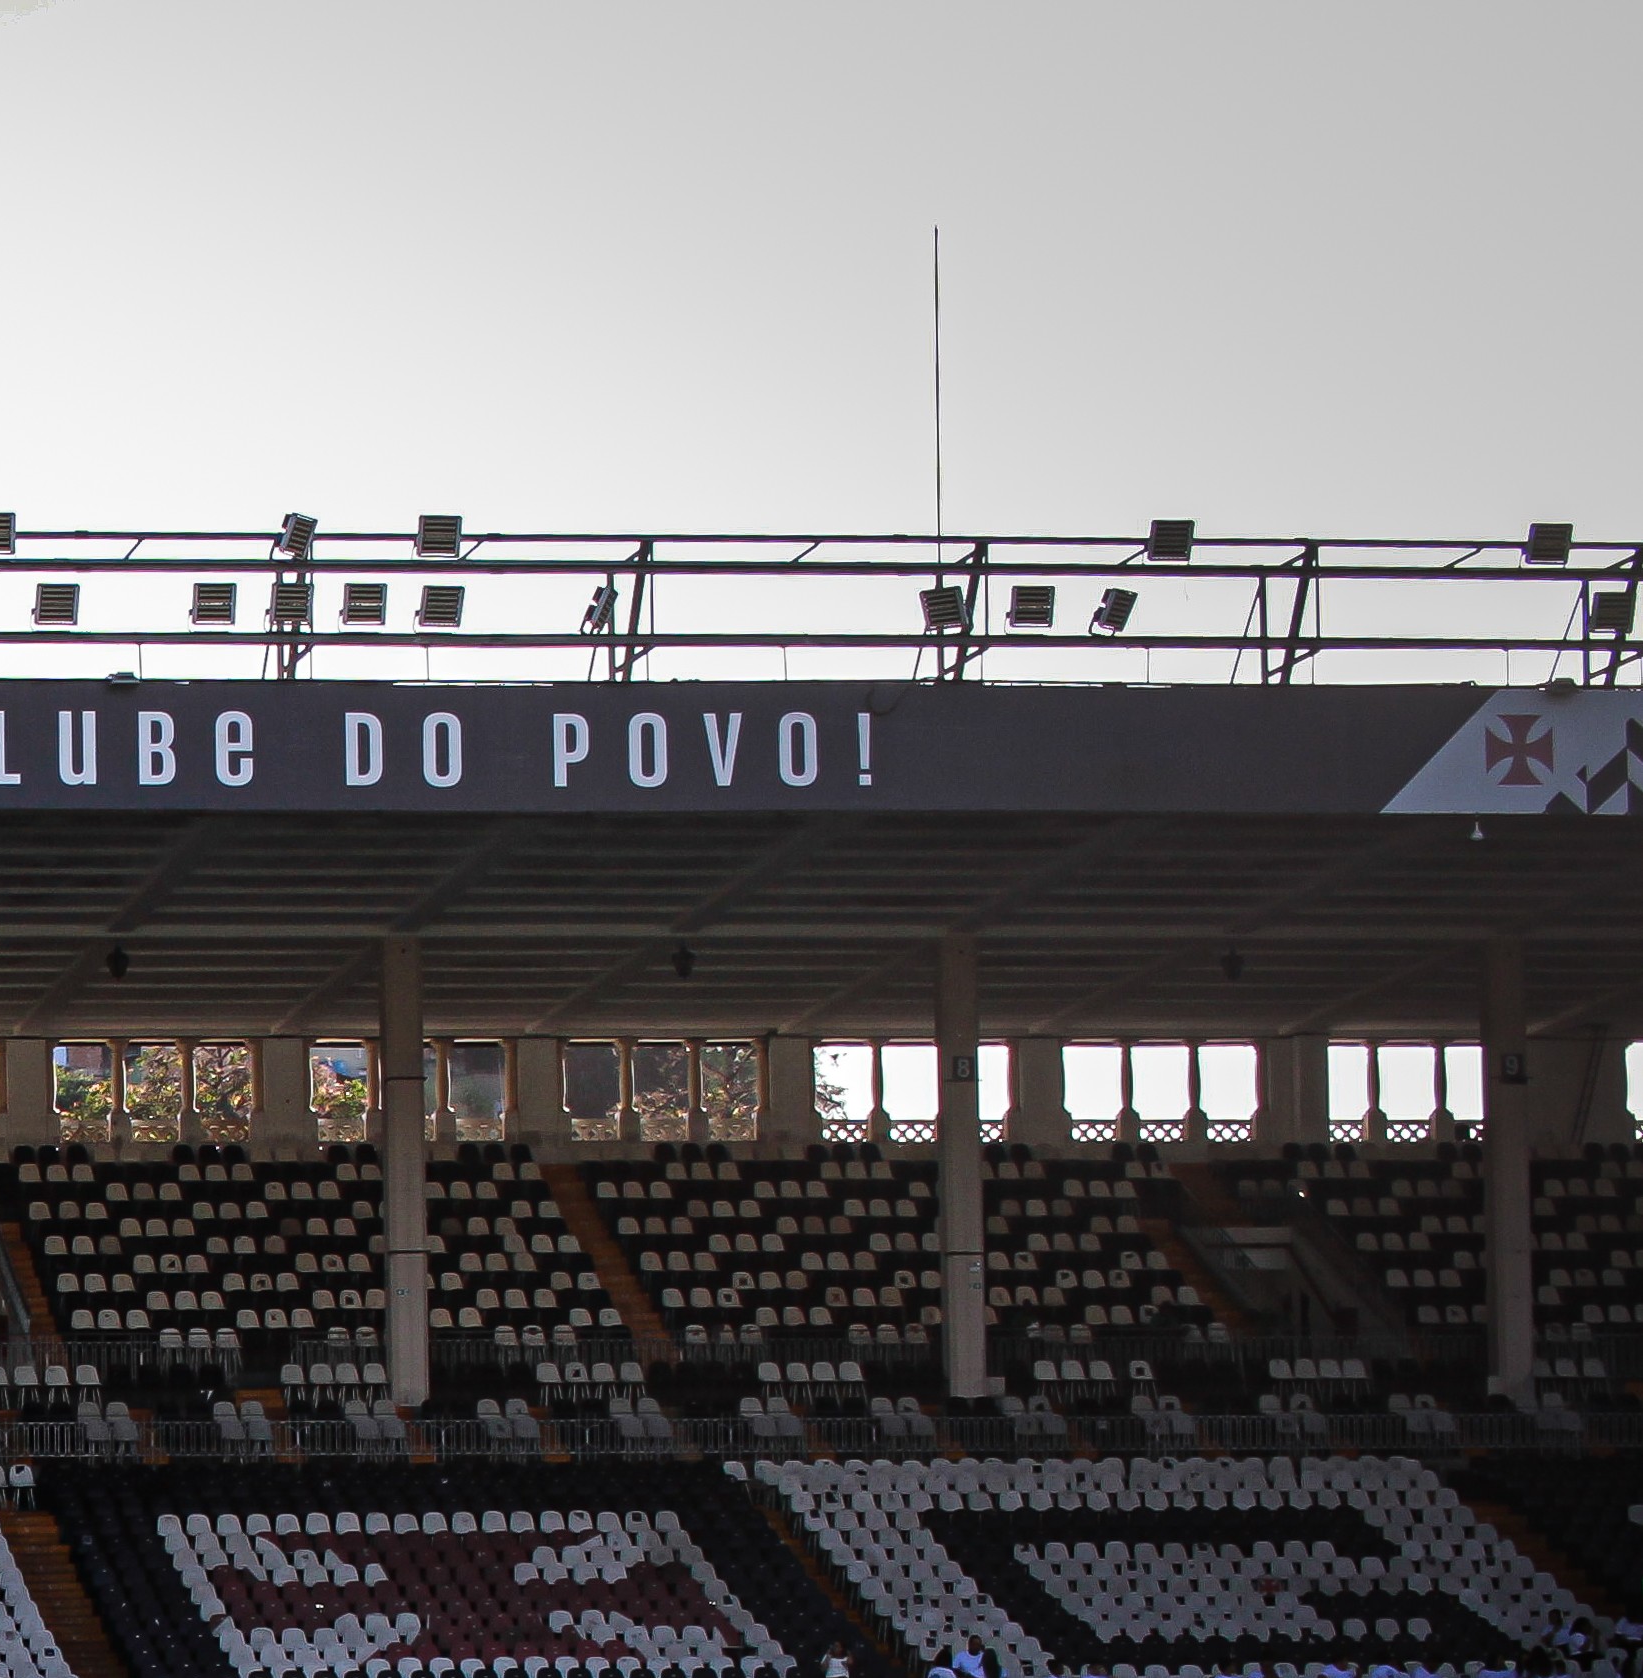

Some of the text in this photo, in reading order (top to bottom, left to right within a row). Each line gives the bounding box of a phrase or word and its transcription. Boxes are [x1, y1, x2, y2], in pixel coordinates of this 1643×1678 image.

[344, 711, 463, 788] DO
[552, 711, 872, 788] POVO!
[957, 1058, 970, 1078] 8
[1505, 1055, 1519, 1075] 9
